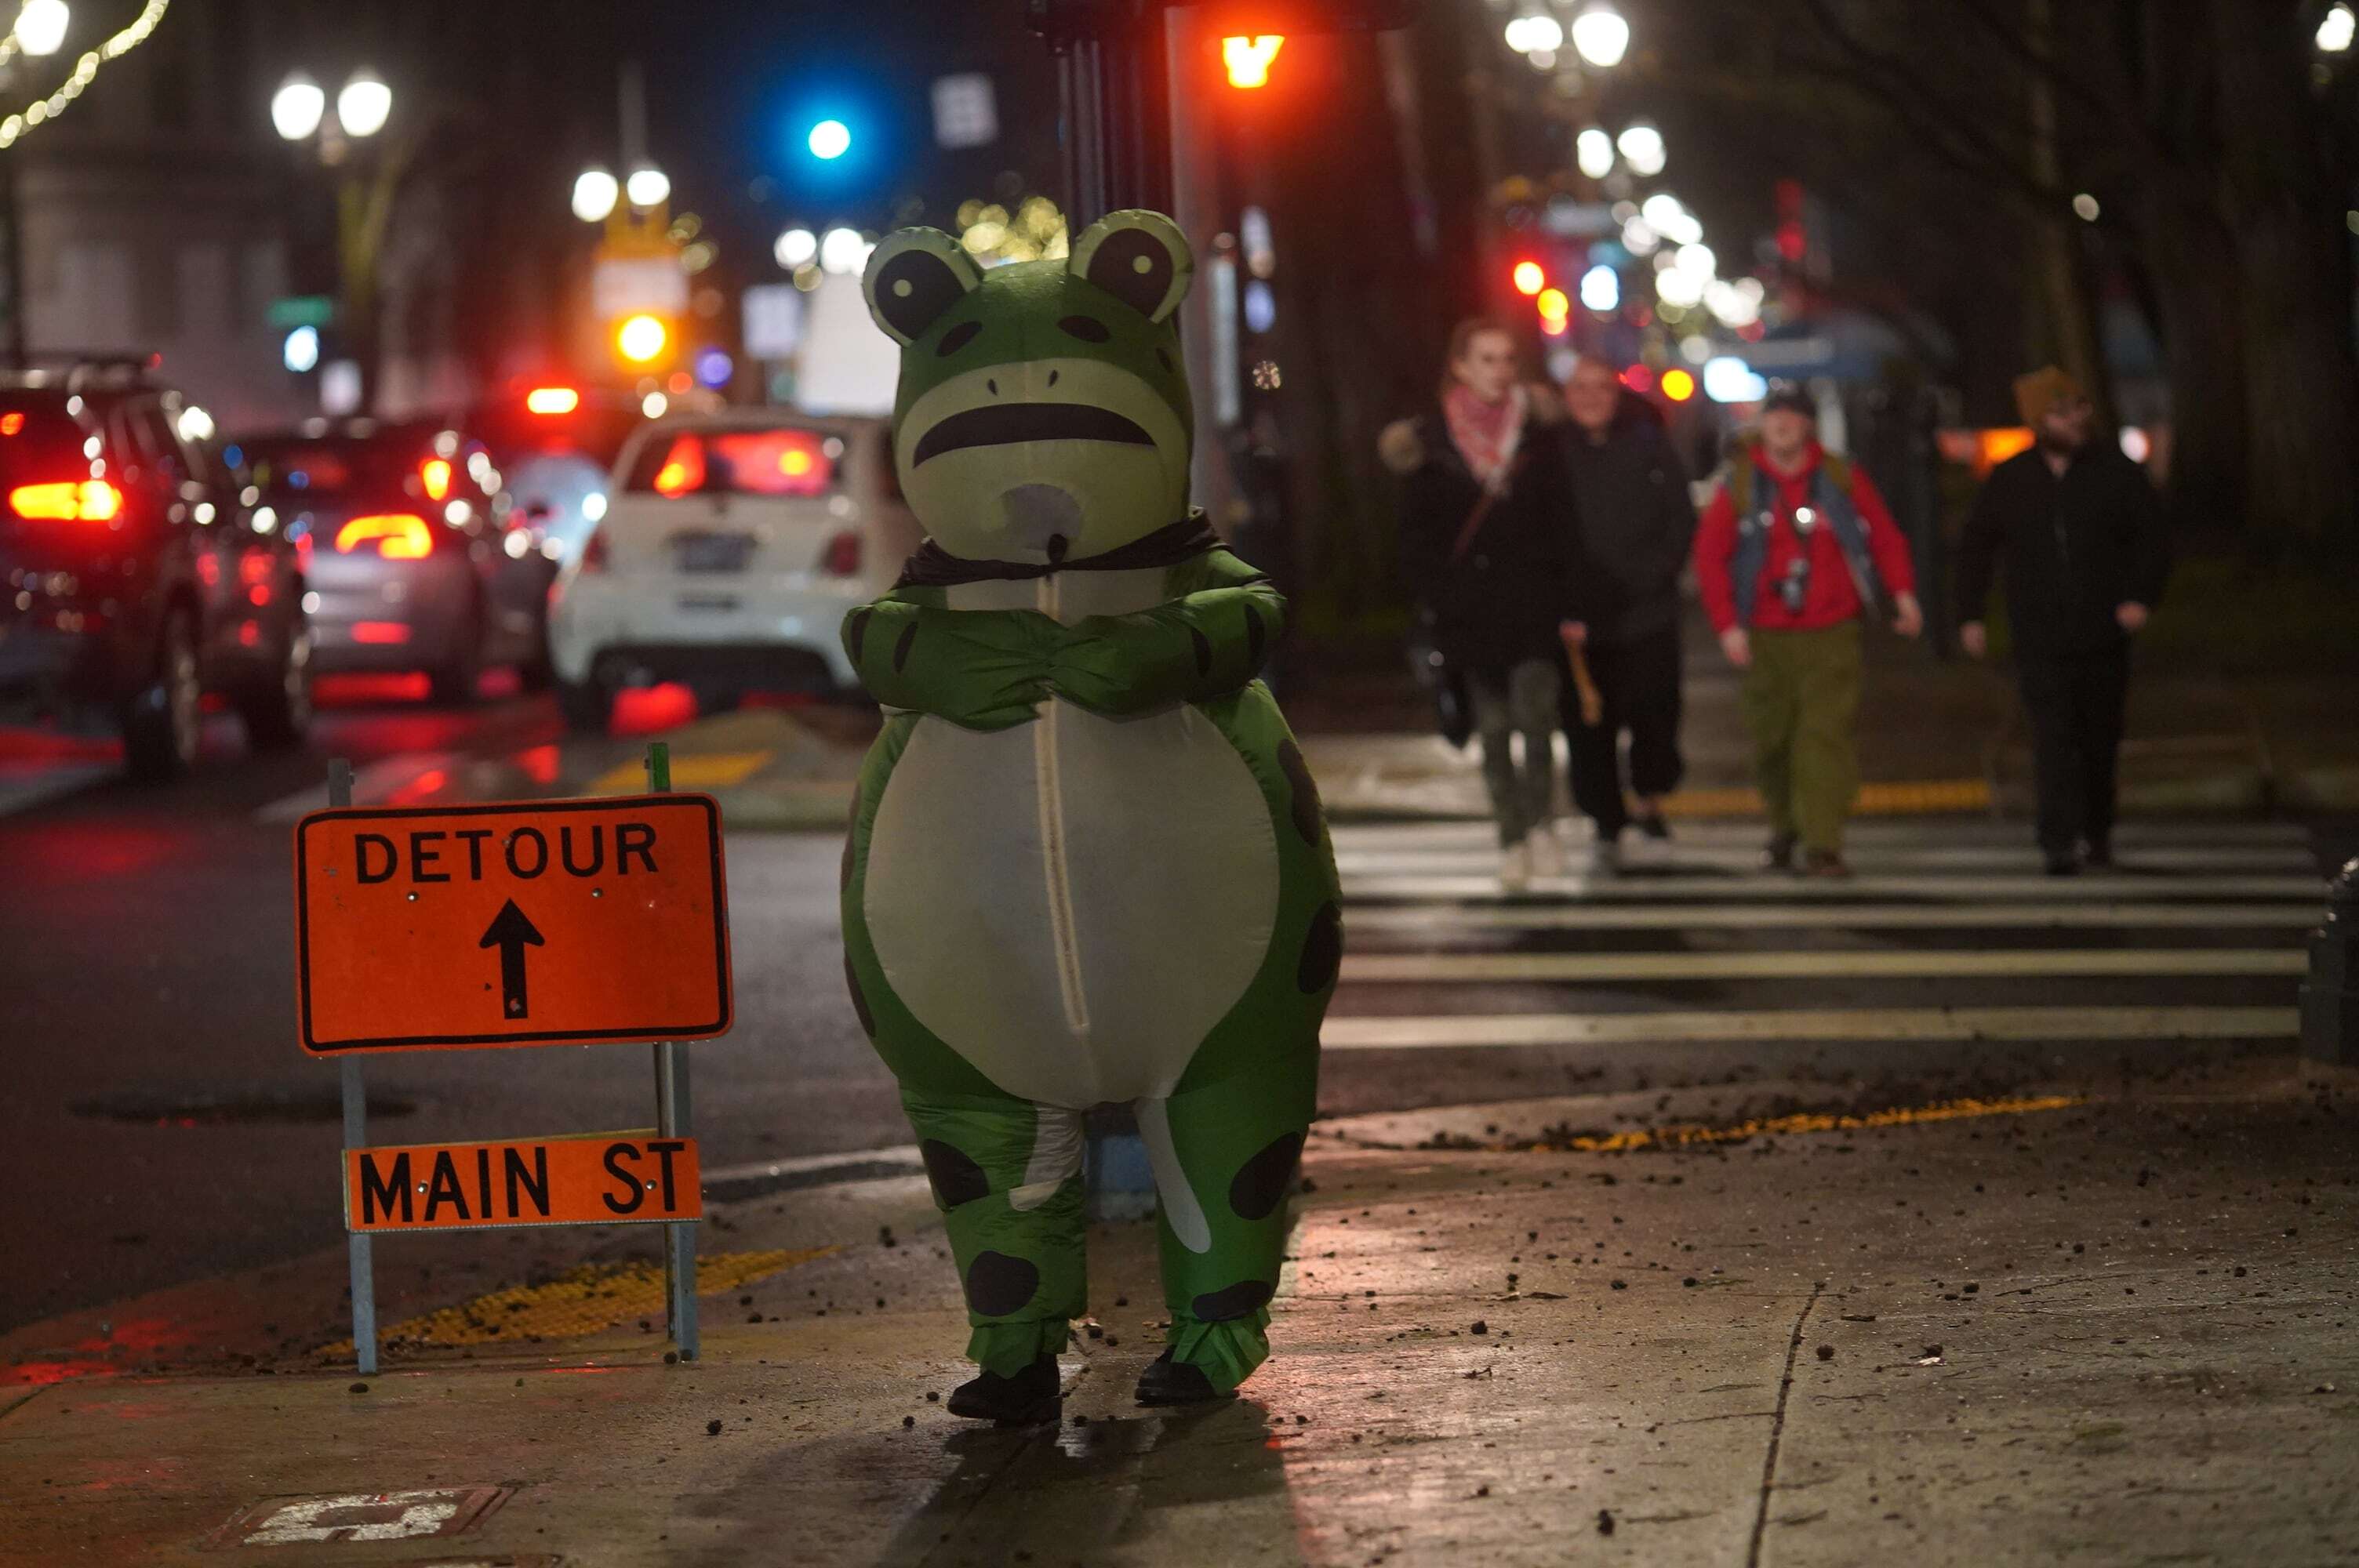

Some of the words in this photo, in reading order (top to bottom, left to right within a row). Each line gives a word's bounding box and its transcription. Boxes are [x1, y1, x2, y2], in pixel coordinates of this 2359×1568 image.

[354, 823, 659, 884] DETOUR
[360, 1147, 550, 1224] MAIN
[603, 1142, 685, 1214] ST
